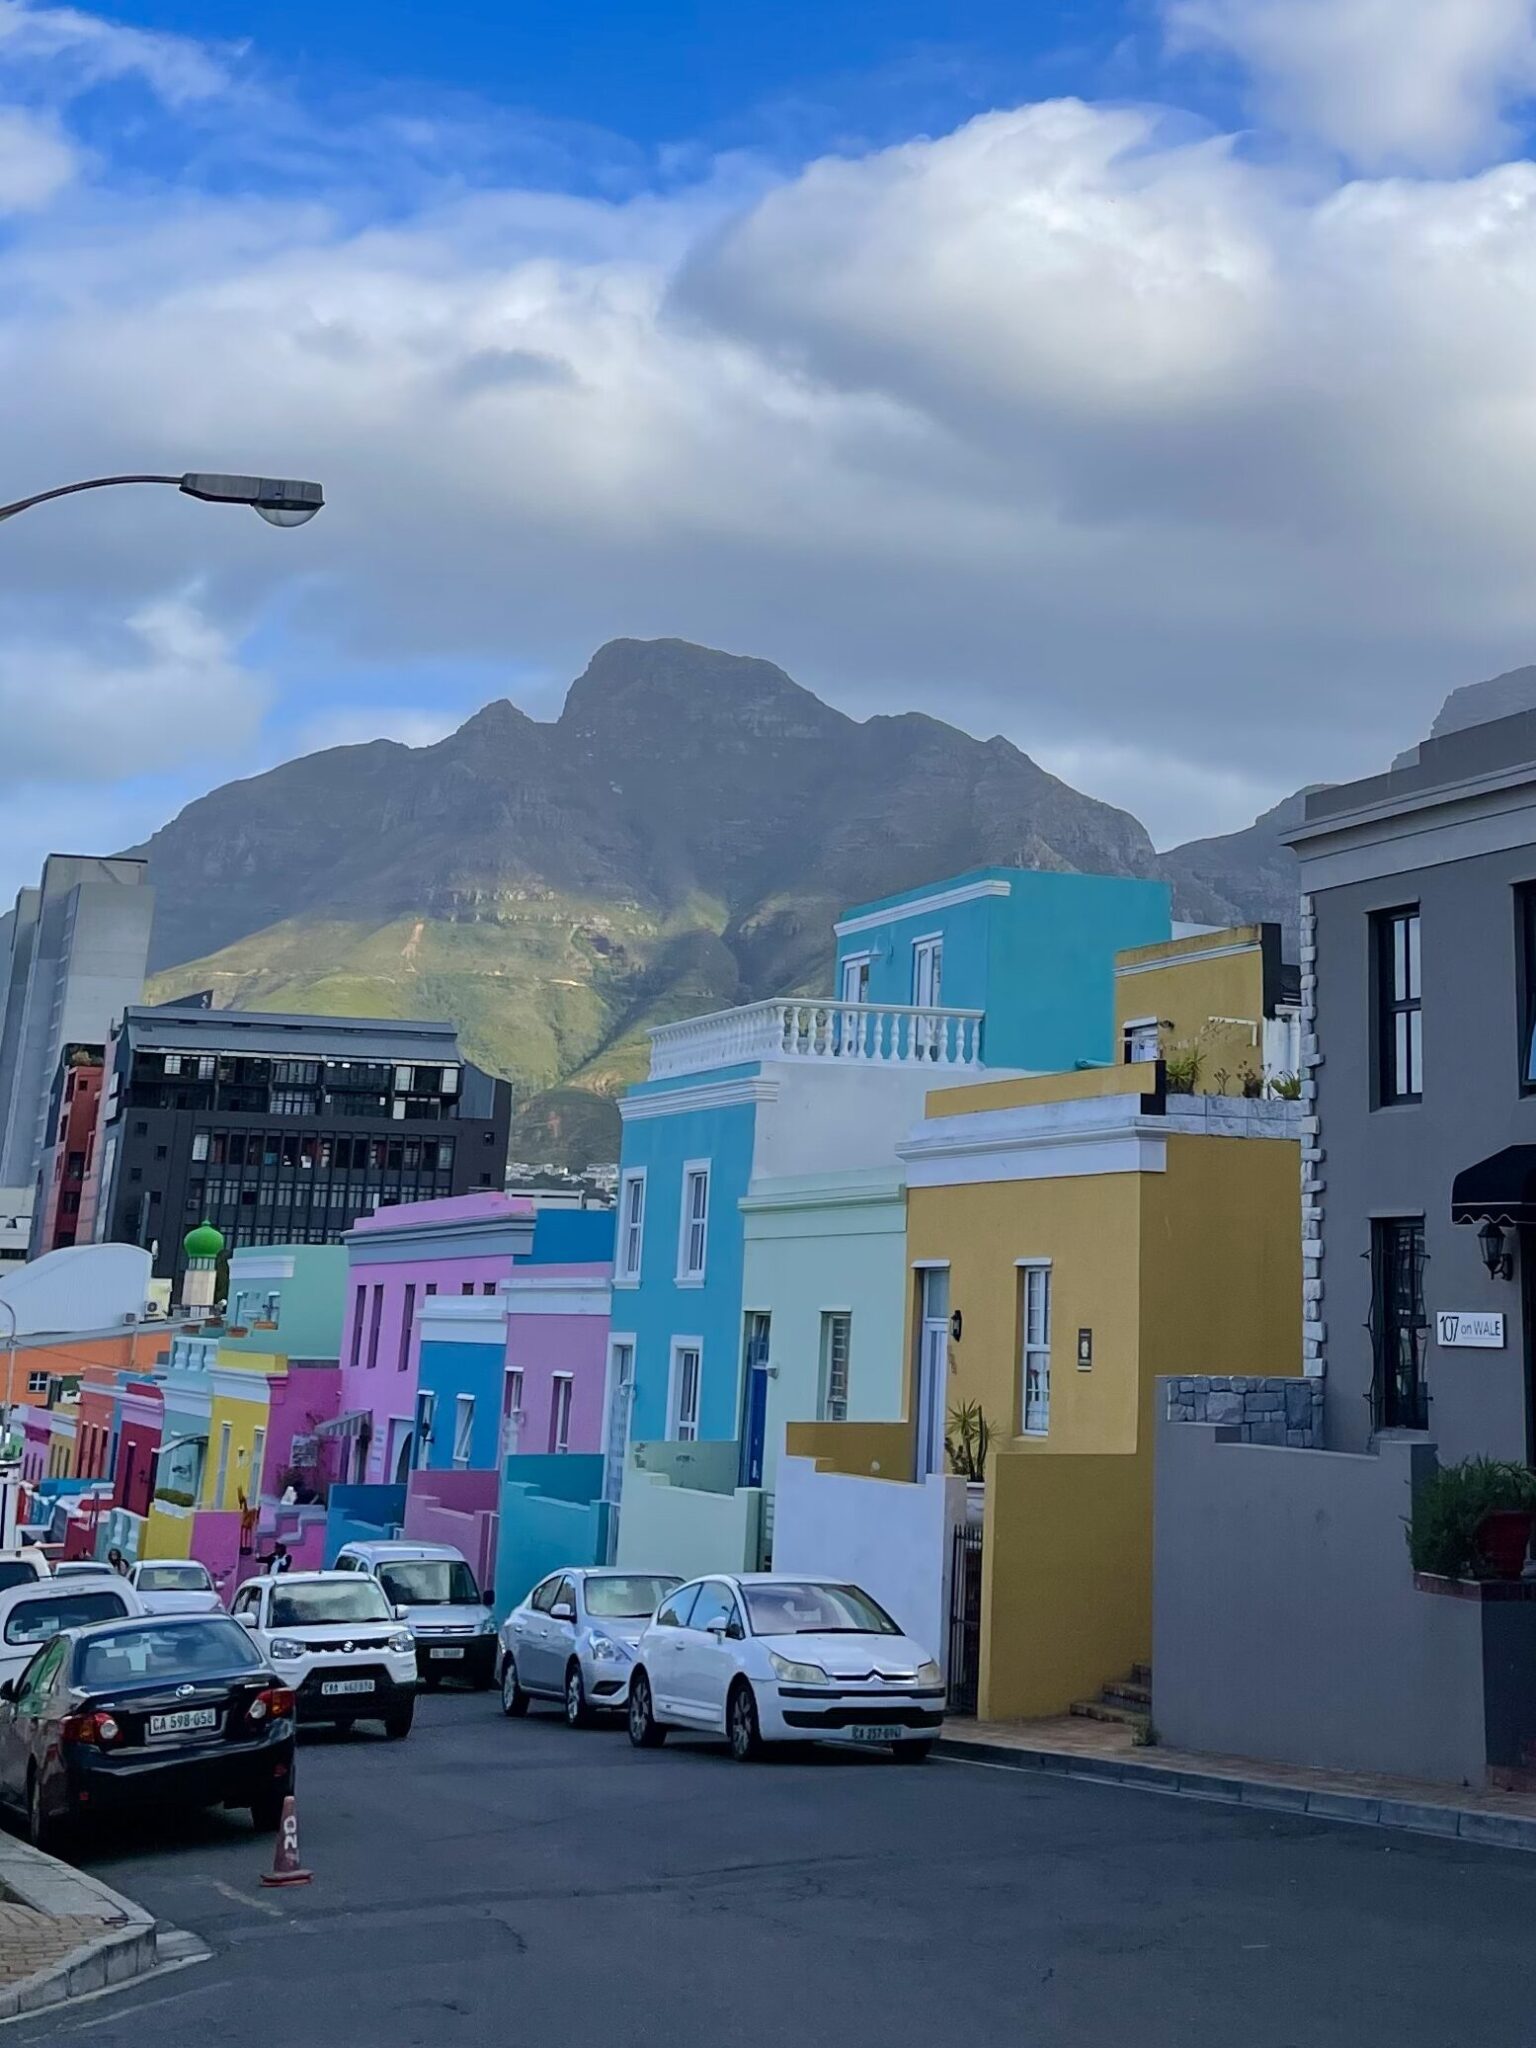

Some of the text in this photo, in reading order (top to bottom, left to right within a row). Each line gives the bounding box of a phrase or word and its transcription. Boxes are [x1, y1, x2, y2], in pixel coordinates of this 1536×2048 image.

[1440, 1316, 1501, 1342] 107 on WALE
[153, 1717, 166, 1731] CA
